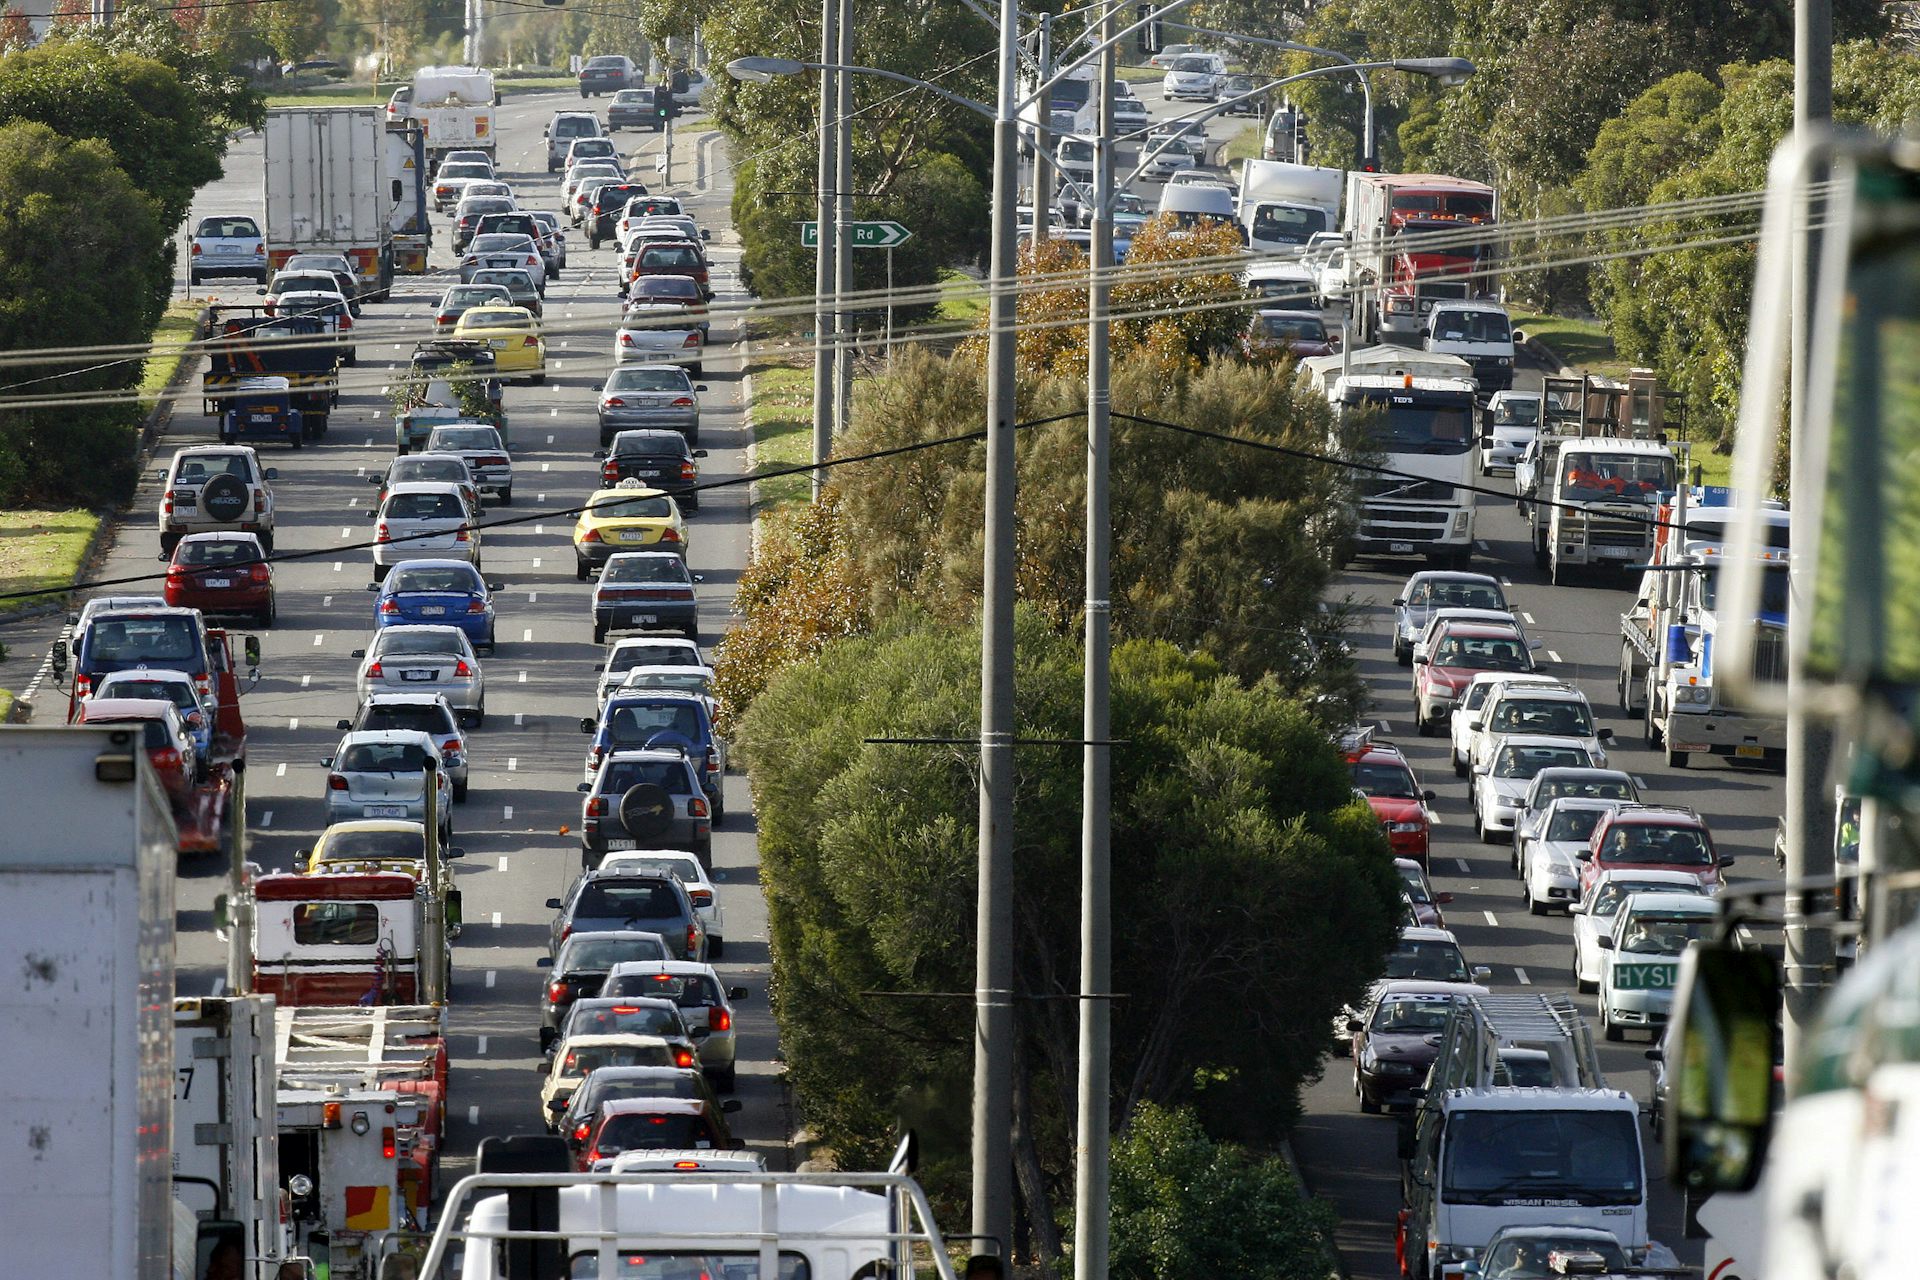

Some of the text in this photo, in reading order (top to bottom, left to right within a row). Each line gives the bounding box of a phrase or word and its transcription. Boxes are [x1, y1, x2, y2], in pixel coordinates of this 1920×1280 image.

[857, 229, 874, 240] Rd
[1393, 396, 1413, 404] TED'S
[1503, 1198, 1583, 1208] NISSAN DIESEL
